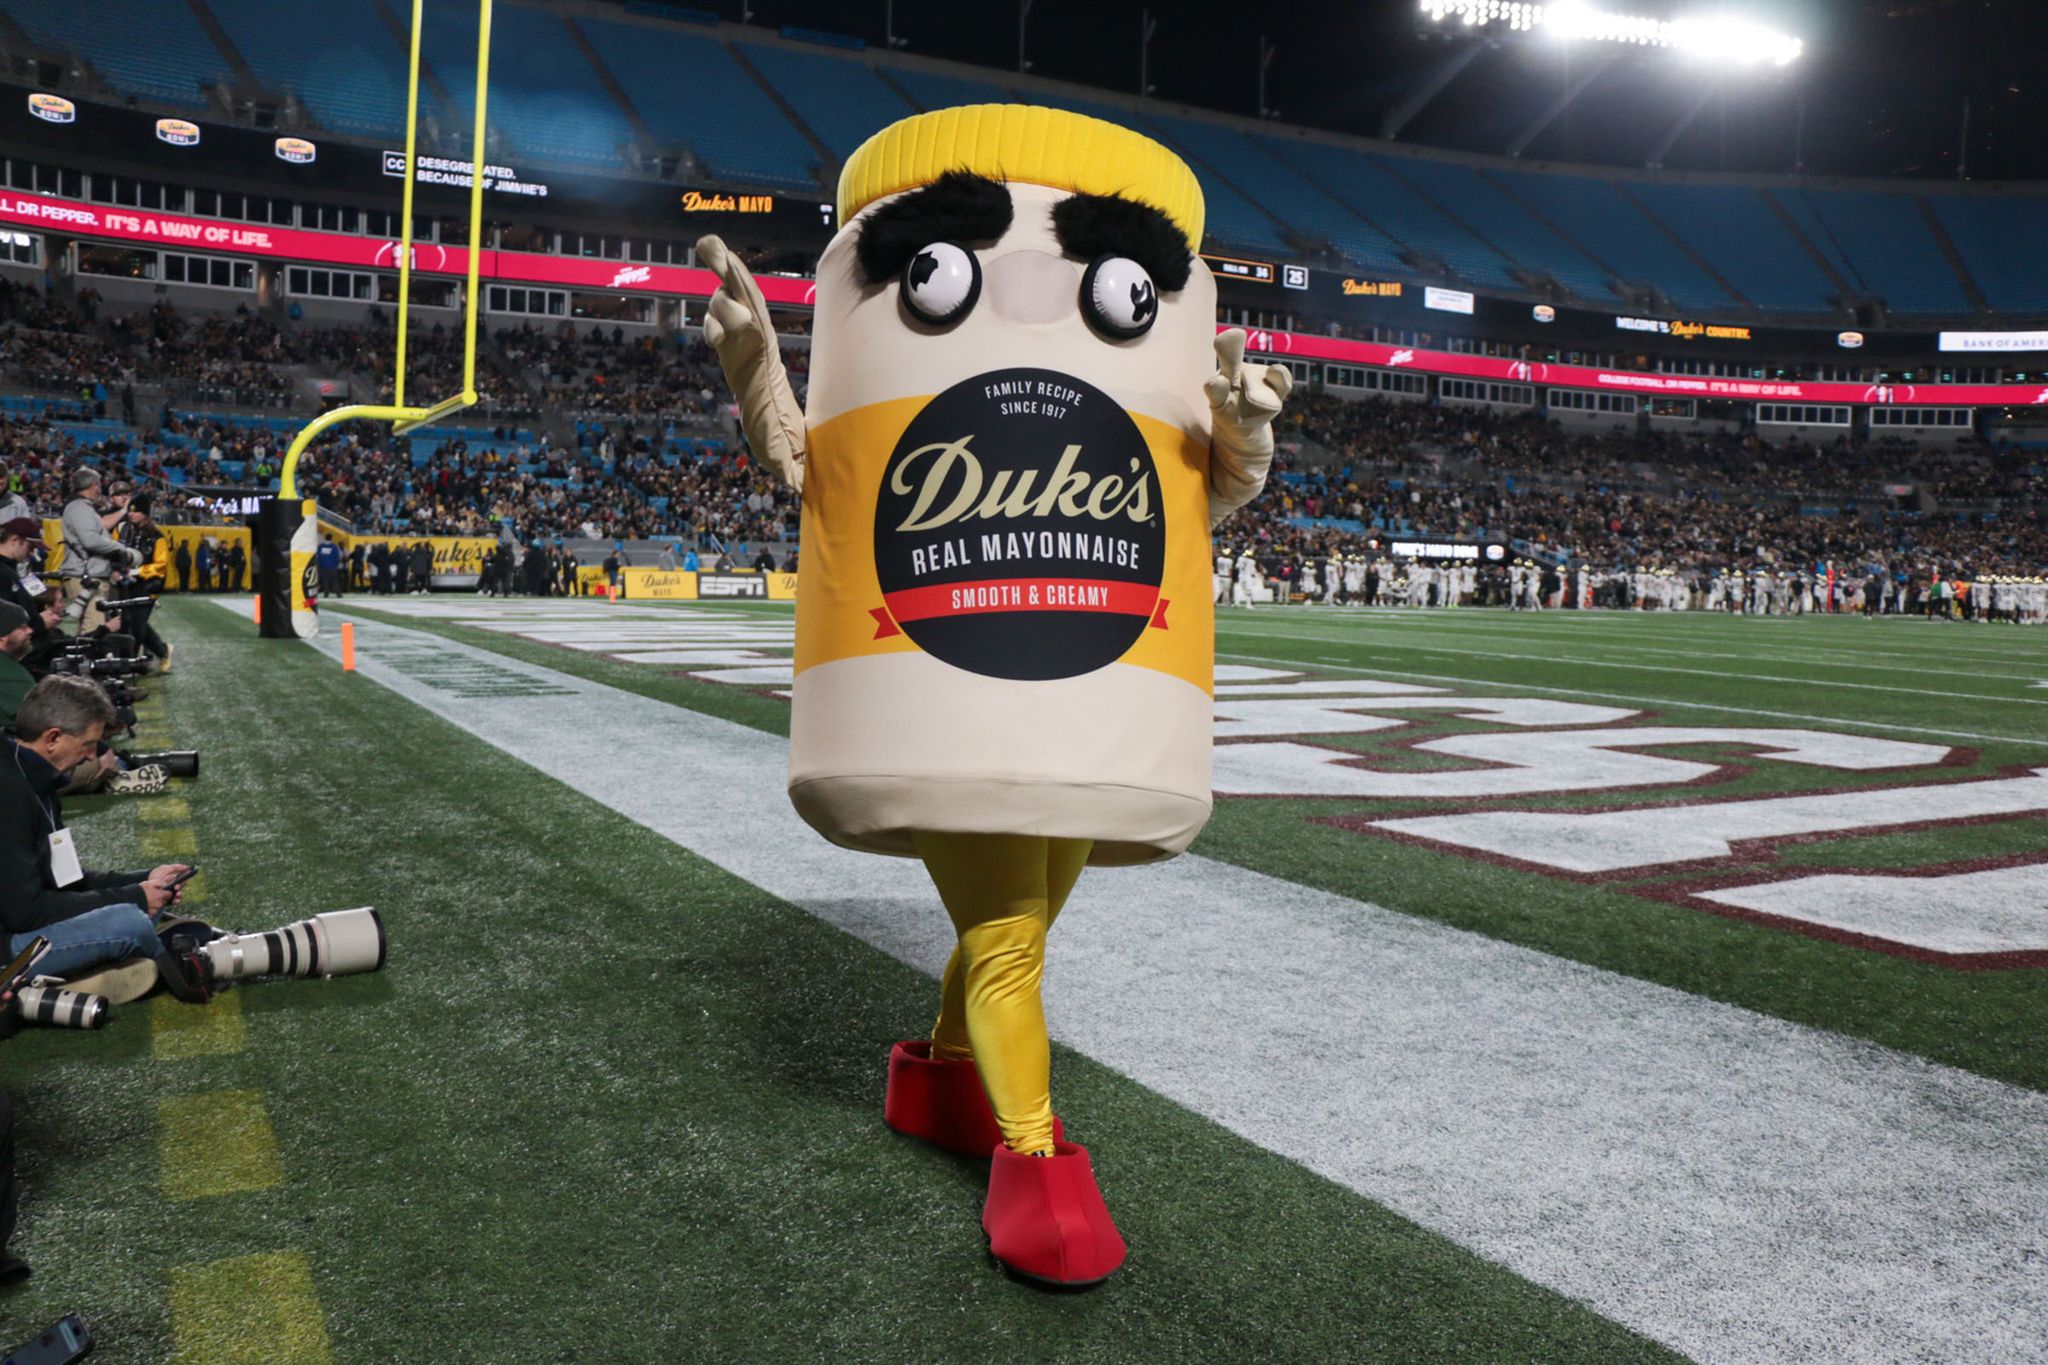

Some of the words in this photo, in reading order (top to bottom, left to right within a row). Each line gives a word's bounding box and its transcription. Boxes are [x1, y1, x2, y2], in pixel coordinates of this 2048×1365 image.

[387, 157, 405, 171] CC
[417, 156, 516, 179] DESEGREATED.
[417, 170, 474, 187] BECAUSE
[682, 191, 736, 211] Duke's
[739, 196, 773, 213] MAYO
[16, 201, 38, 216] DR
[41, 205, 98, 226] PEPPER.
[105, 214, 140, 232] IT'S
[143, 218, 158, 235] A
[160, 220, 200, 240] WAY
[204, 226, 229, 243] OF
[232, 229, 272, 248] LIFE.
[2012, 338, 2048, 347] AMER
[985, 381, 1032, 399] FAMILY
[1037, 382, 1083, 406] RECIPE
[1000, 401, 1037, 415] SINCE
[1042, 403, 1067, 419] 1917
[891, 434, 1155, 532] Duke's
[912, 540, 971, 576] REAL
[981, 531, 1140, 570] MAYONNAISE
[641, 574, 680, 588] Duke's
[700, 576, 764, 595] ESPN
[952, 586, 1021, 609] SMOOTH
[1028, 585, 1040, 605] &
[1046, 585, 1109, 607] CREAMY
